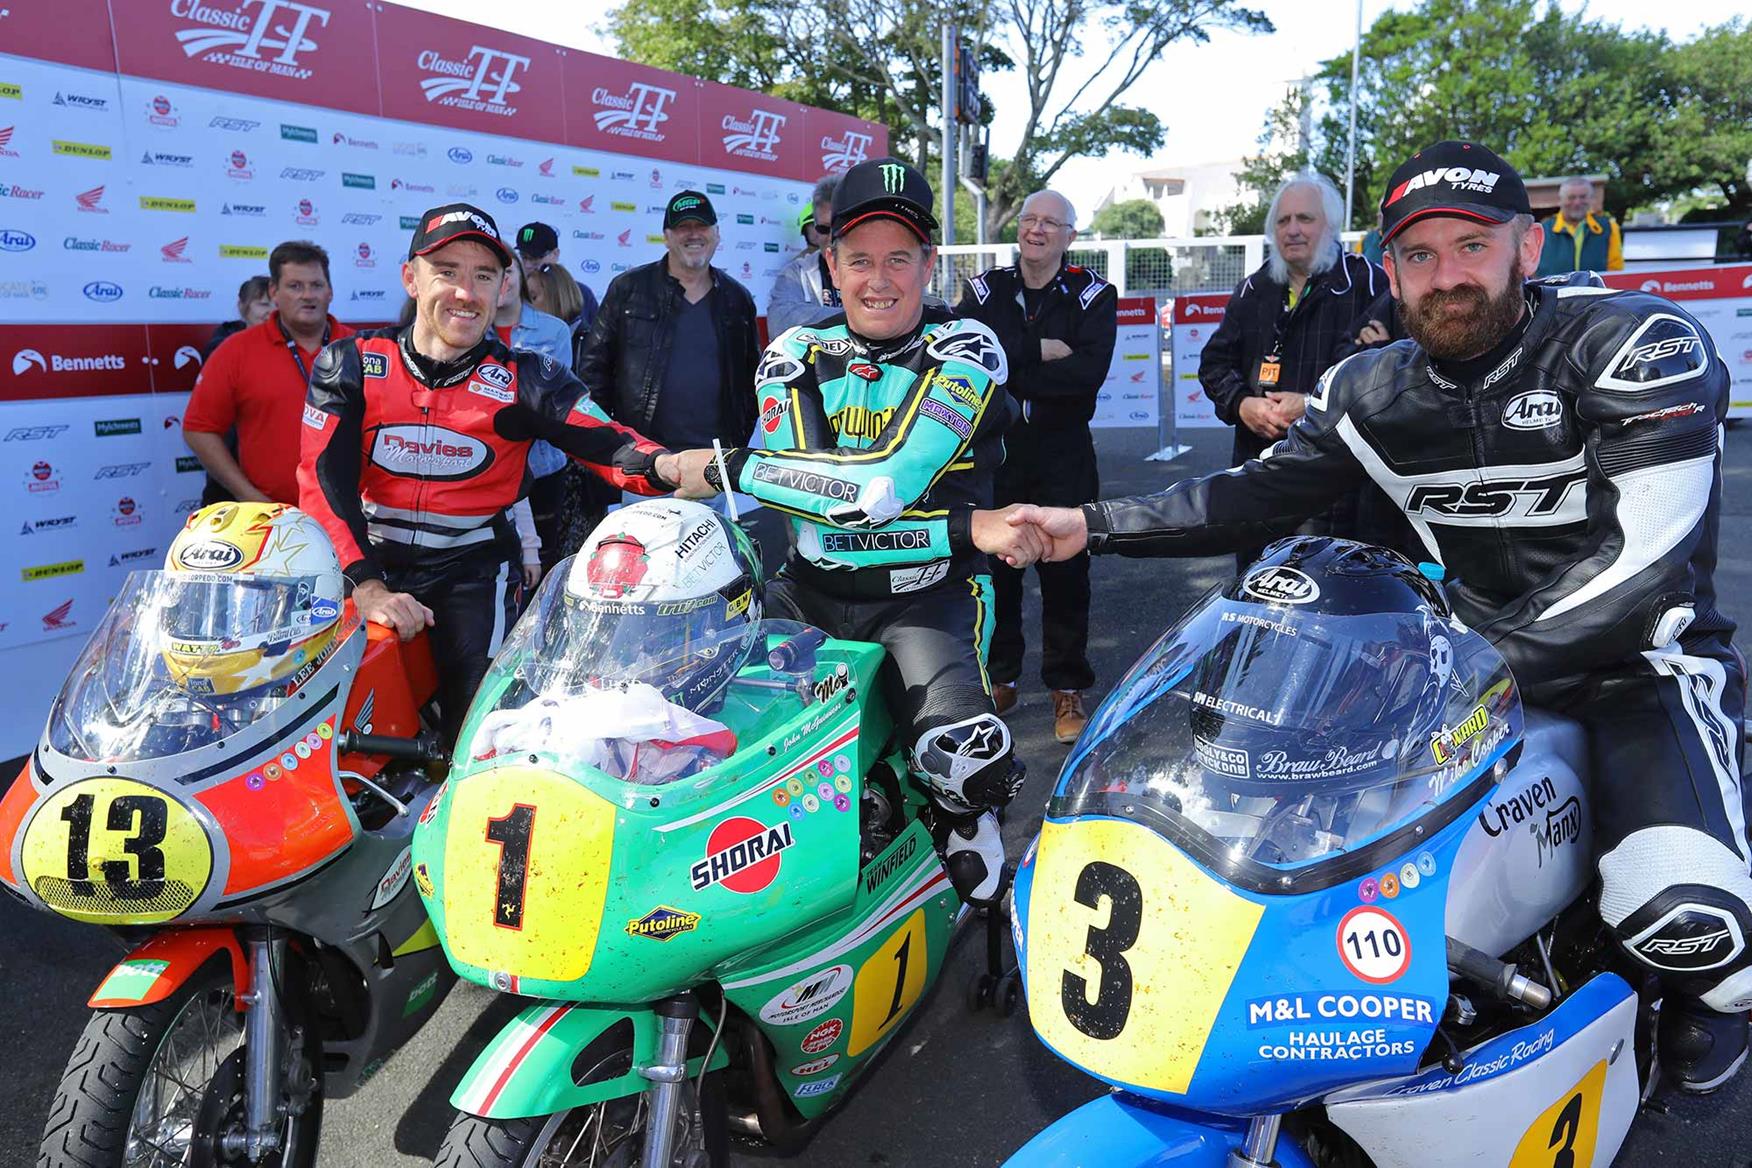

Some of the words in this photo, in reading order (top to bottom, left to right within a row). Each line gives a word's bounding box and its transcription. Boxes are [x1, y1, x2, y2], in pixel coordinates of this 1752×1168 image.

[171, 0, 250, 31] Classic
[229, 55, 256, 69] ISLE
[254, 60, 271, 73] OF
[269, 63, 297, 77] MAN
[417, 49, 474, 78] Classic
[461, 45, 531, 105] TT
[592, 87, 633, 110] Classic
[626, 82, 677, 132] TT
[722, 114, 755, 134] Classic
[749, 109, 787, 153] TT
[63, 145, 110, 157] DUNLOP
[821, 136, 846, 150] Classic
[843, 130, 873, 167] TT
[10, 186, 44, 200] Racer
[1402, 167, 1500, 198] AVON
[1451, 181, 1494, 194] TYRES
[151, 201, 194, 210] DUNLOP
[63, 237, 100, 251] Classic
[101, 240, 131, 253] Racer
[90, 281, 119, 297] Arai
[149, 286, 183, 299] Classic
[184, 289, 212, 299] Racer
[1203, 306, 1226, 315] Benn
[51, 354, 126, 372] Bennetts
[362, 356, 381, 365] ona
[1620, 336, 1700, 372] RST
[1261, 367, 1277, 378] PIT
[1484, 348, 1523, 390] RST
[3, 424, 70, 442] RST
[384, 434, 473, 457] Davies
[754, 463, 857, 502] BETVICTOR
[1404, 478, 1588, 517] RST
[674, 518, 717, 560] HITACHI
[824, 530, 928, 552] BETVICTOR
[181, 545, 238, 563] Arai
[34, 562, 84, 577] DUNLOP
[1248, 568, 1312, 598] Arai
[1221, 612, 1236, 622] RS
[1236, 614, 1297, 637] MOTORCYCLES
[292, 661, 315, 687] LEE
[783, 733, 801, 752] John
[1255, 749, 1320, 773] Braw
[1320, 740, 1383, 771] Beard
[1428, 760, 1469, 797] Mike
[1471, 722, 1510, 768] Cooper
[1256, 760, 1377, 780] www.brawbeard.com
[1479, 776, 1557, 838] Craven
[1530, 796, 1581, 868] Manx
[61, 794, 169, 901] 13
[692, 823, 793, 891] SHORAI
[485, 803, 536, 931] 1
[867, 836, 917, 895] WINFIELD
[629, 913, 697, 936] Putoline
[1062, 861, 1142, 1040] 3
[1347, 929, 1401, 959] 110
[1641, 929, 1730, 955] RST
[878, 931, 911, 1030] 1
[782, 1014, 800, 1023] ISLE
[801, 1011, 812, 1019] OF
[812, 1003, 829, 1014] MAN
[1250, 998, 1311, 1024] M&L
[1318, 995, 1433, 1023] COOPER
[810, 1023, 837, 1040] NGK
[1289, 1029, 1386, 1046] HAULAGE
[1259, 1041, 1414, 1060] CONTRACTORS
[1454, 1055, 1510, 1085] Classic
[1510, 1028, 1555, 1066] Racing
[1548, 1092, 1582, 1168] 3
